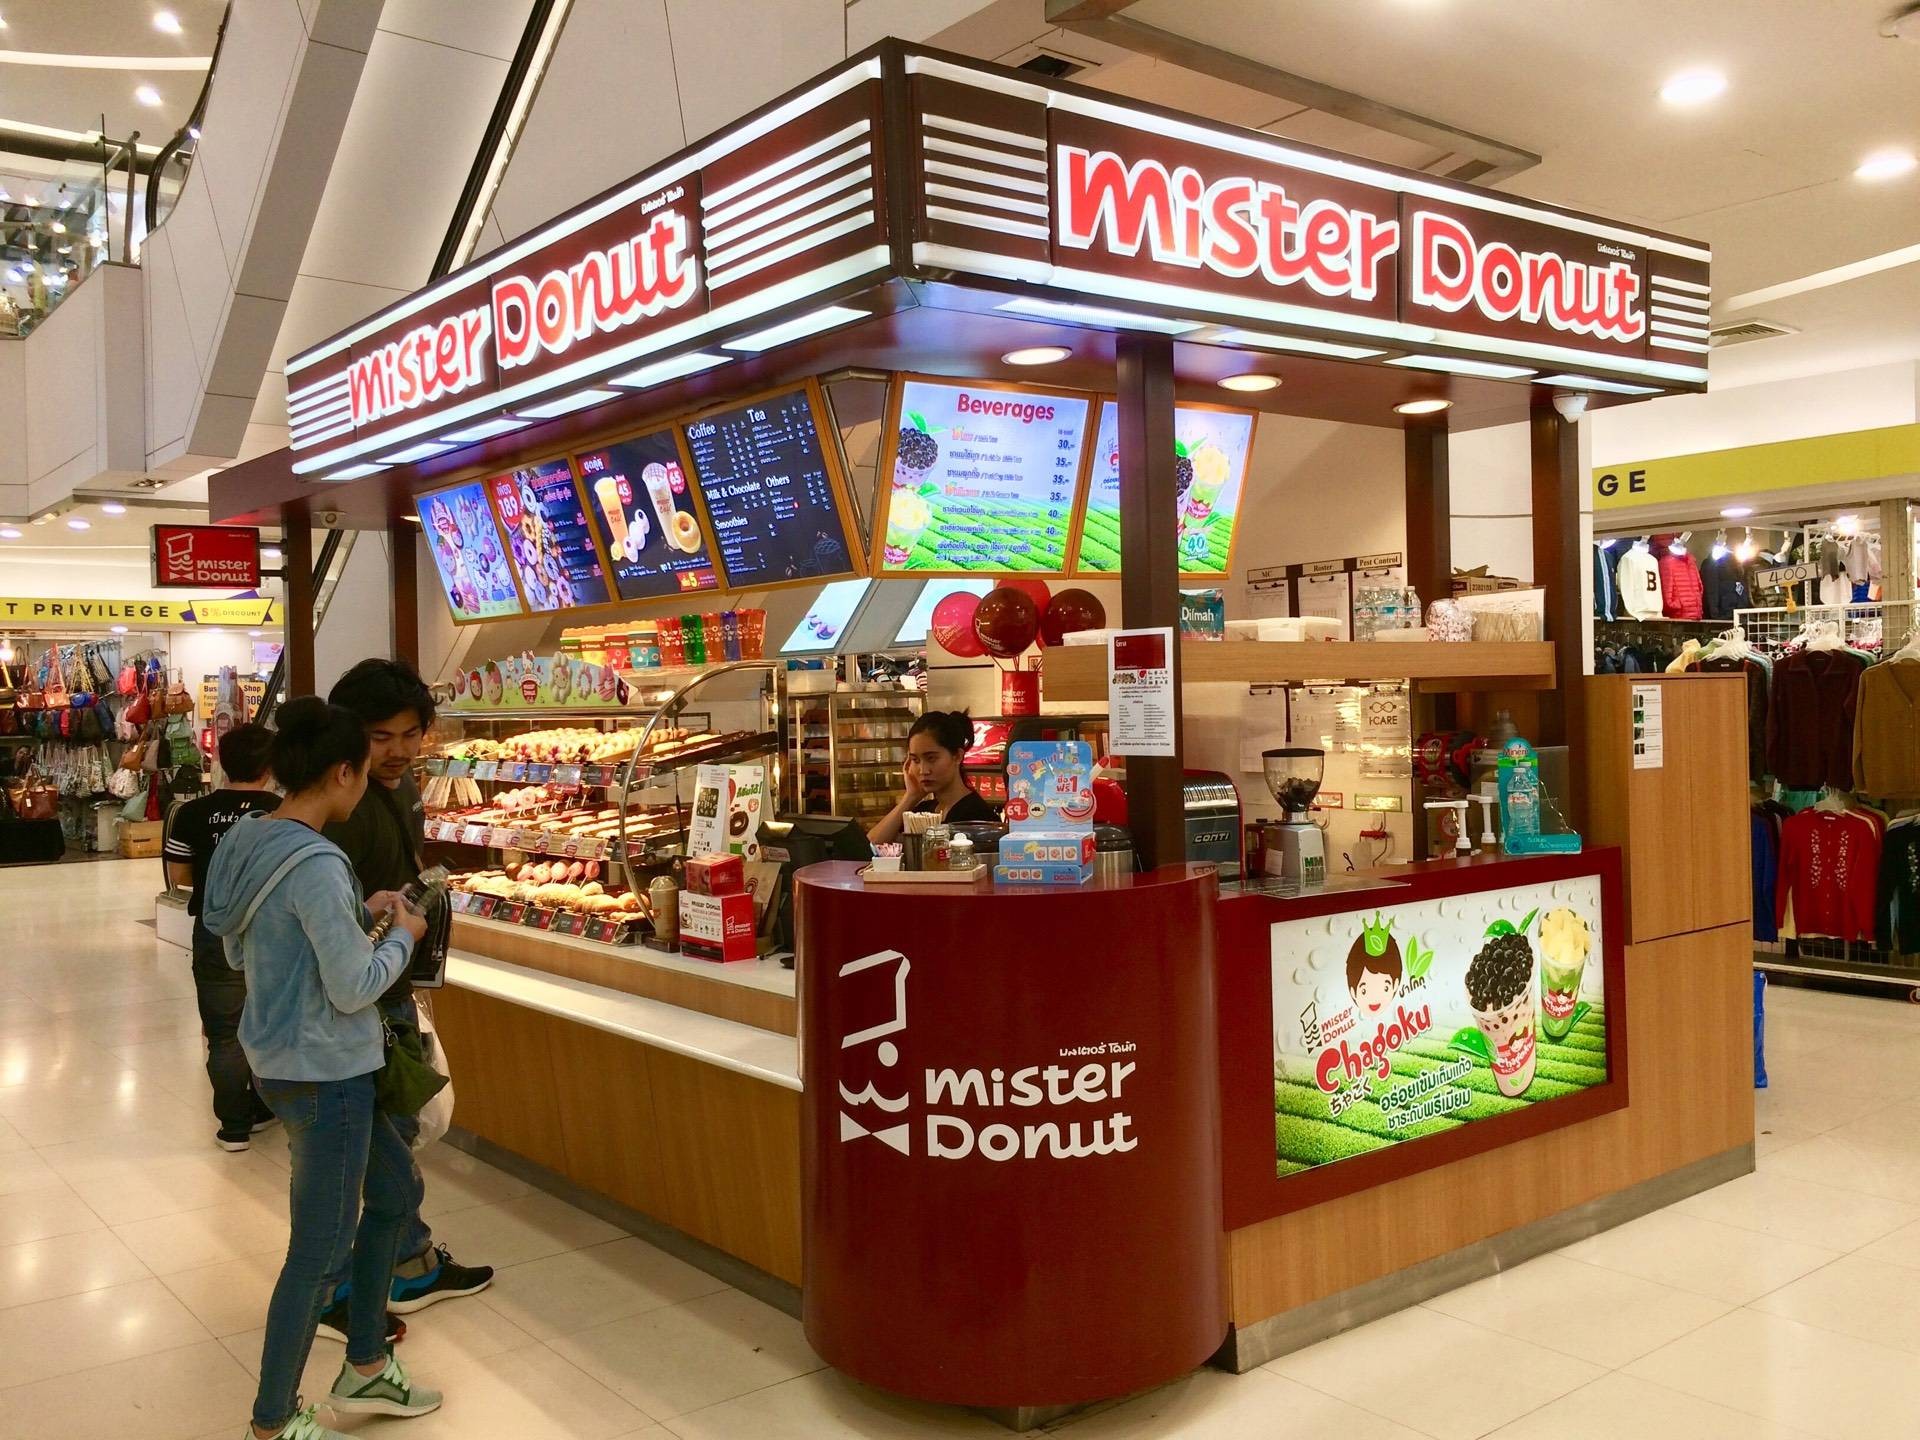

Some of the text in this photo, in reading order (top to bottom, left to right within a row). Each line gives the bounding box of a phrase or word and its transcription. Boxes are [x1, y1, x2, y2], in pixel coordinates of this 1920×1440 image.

[1412, 211, 1644, 342] Donut
[492, 208, 697, 370] Donut
[747, 409, 766, 423] Tea
[958, 394, 1055, 424] Beverages
[689, 423, 716, 440] Coffee
[766, 475, 790, 488] Others
[706, 481, 760, 501] Milk & Chocolate
[715, 517, 748, 530] Smoothies
[1360, 556, 1398, 566] Pest Control
[198, 571, 252, 582] Donut
[1646, 571, 1657, 591] B
[1769, 566, 1808, 583] 400
[34, 603, 169, 618] PRIVILEGE
[1182, 607, 1214, 621] Dilmah
[1194, 832, 1229, 843] CONTI
[1323, 1019, 1356, 1043] Donut
[1316, 1004, 1432, 1093] Chagoku
[927, 1112, 1138, 1161] Donut
